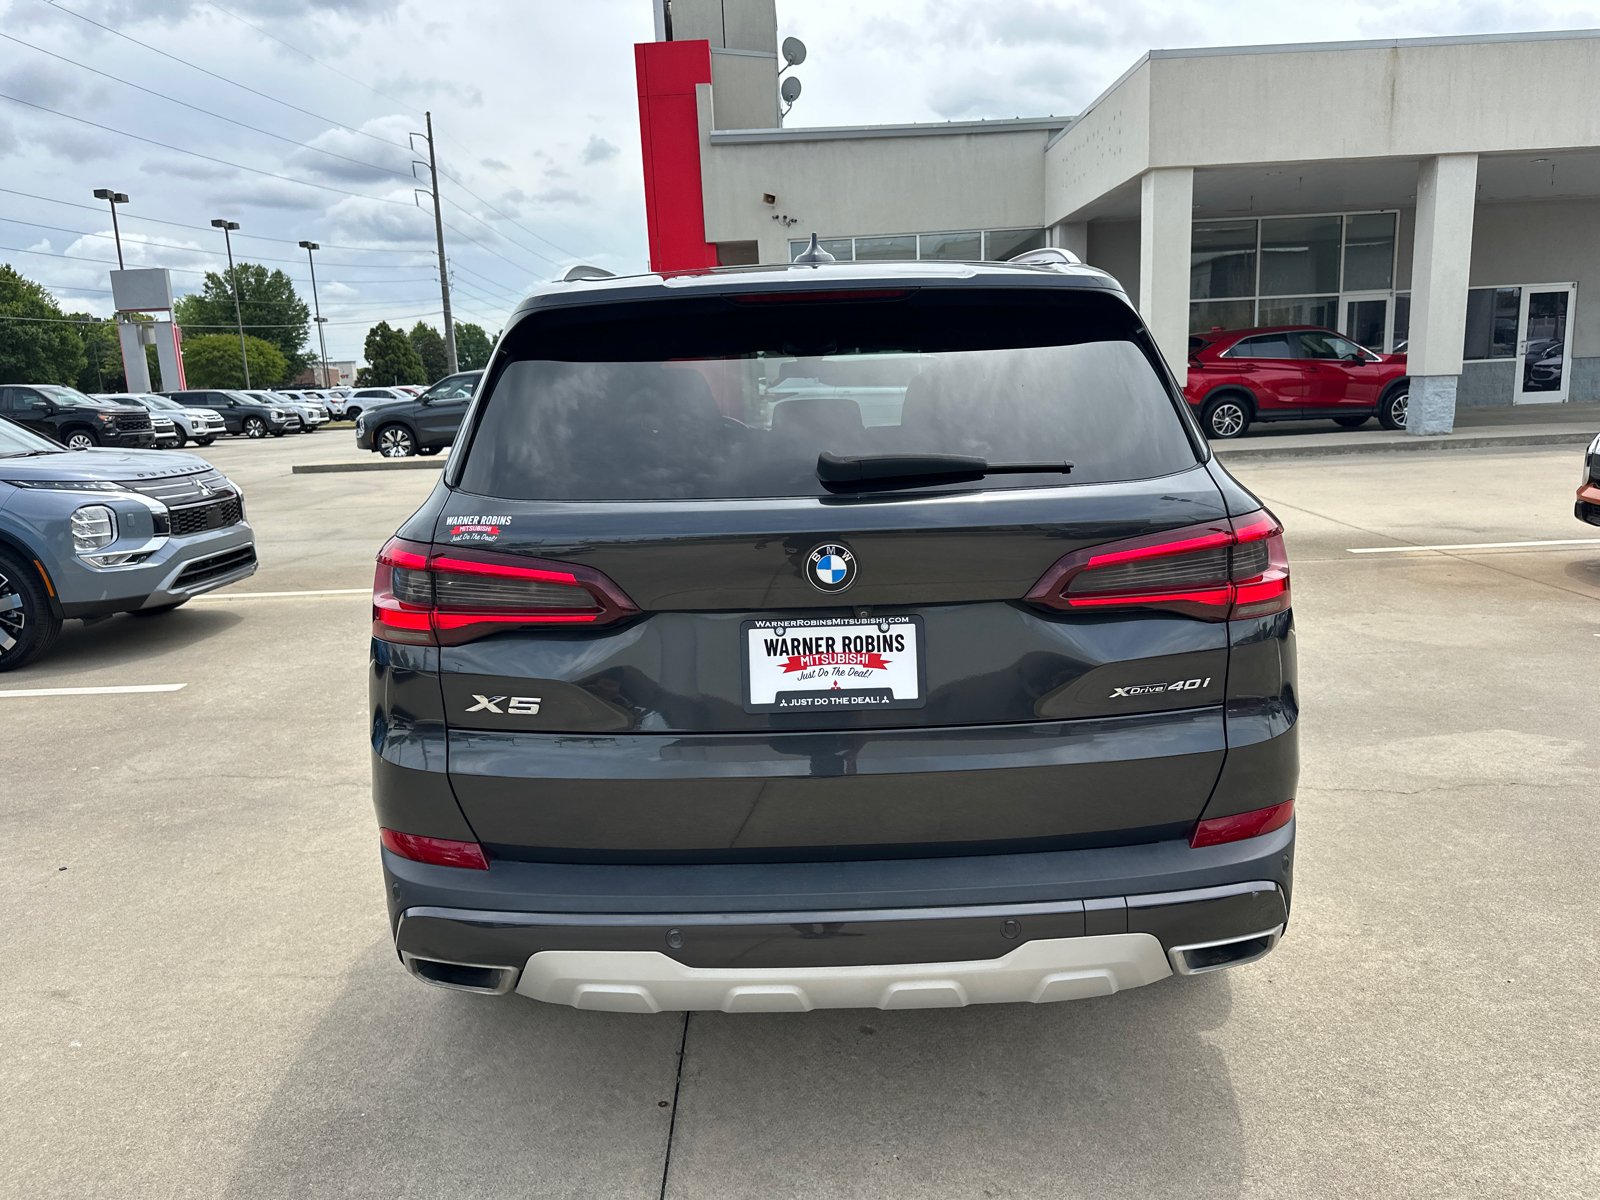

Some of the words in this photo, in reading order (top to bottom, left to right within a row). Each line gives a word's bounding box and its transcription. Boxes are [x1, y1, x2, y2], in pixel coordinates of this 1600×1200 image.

[446, 515, 479, 525] WARNER
[480, 515, 512, 525] ROBINS
[450, 534, 463, 542] Just
[481, 534, 498, 542] Deal!
[811, 546, 852, 562] BMW
[764, 637, 835, 656] WARNER
[842, 634, 904, 653] ROBINS
[800, 653, 869, 667] MITSUBISHI
[797, 669, 816, 681] Just
[817, 667, 829, 677] Do
[831, 666, 846, 677] The
[847, 667, 873, 678] Deal!
[464, 694, 542, 715] X5
[789, 698, 813, 706] JUST
[830, 697, 850, 705] THE
